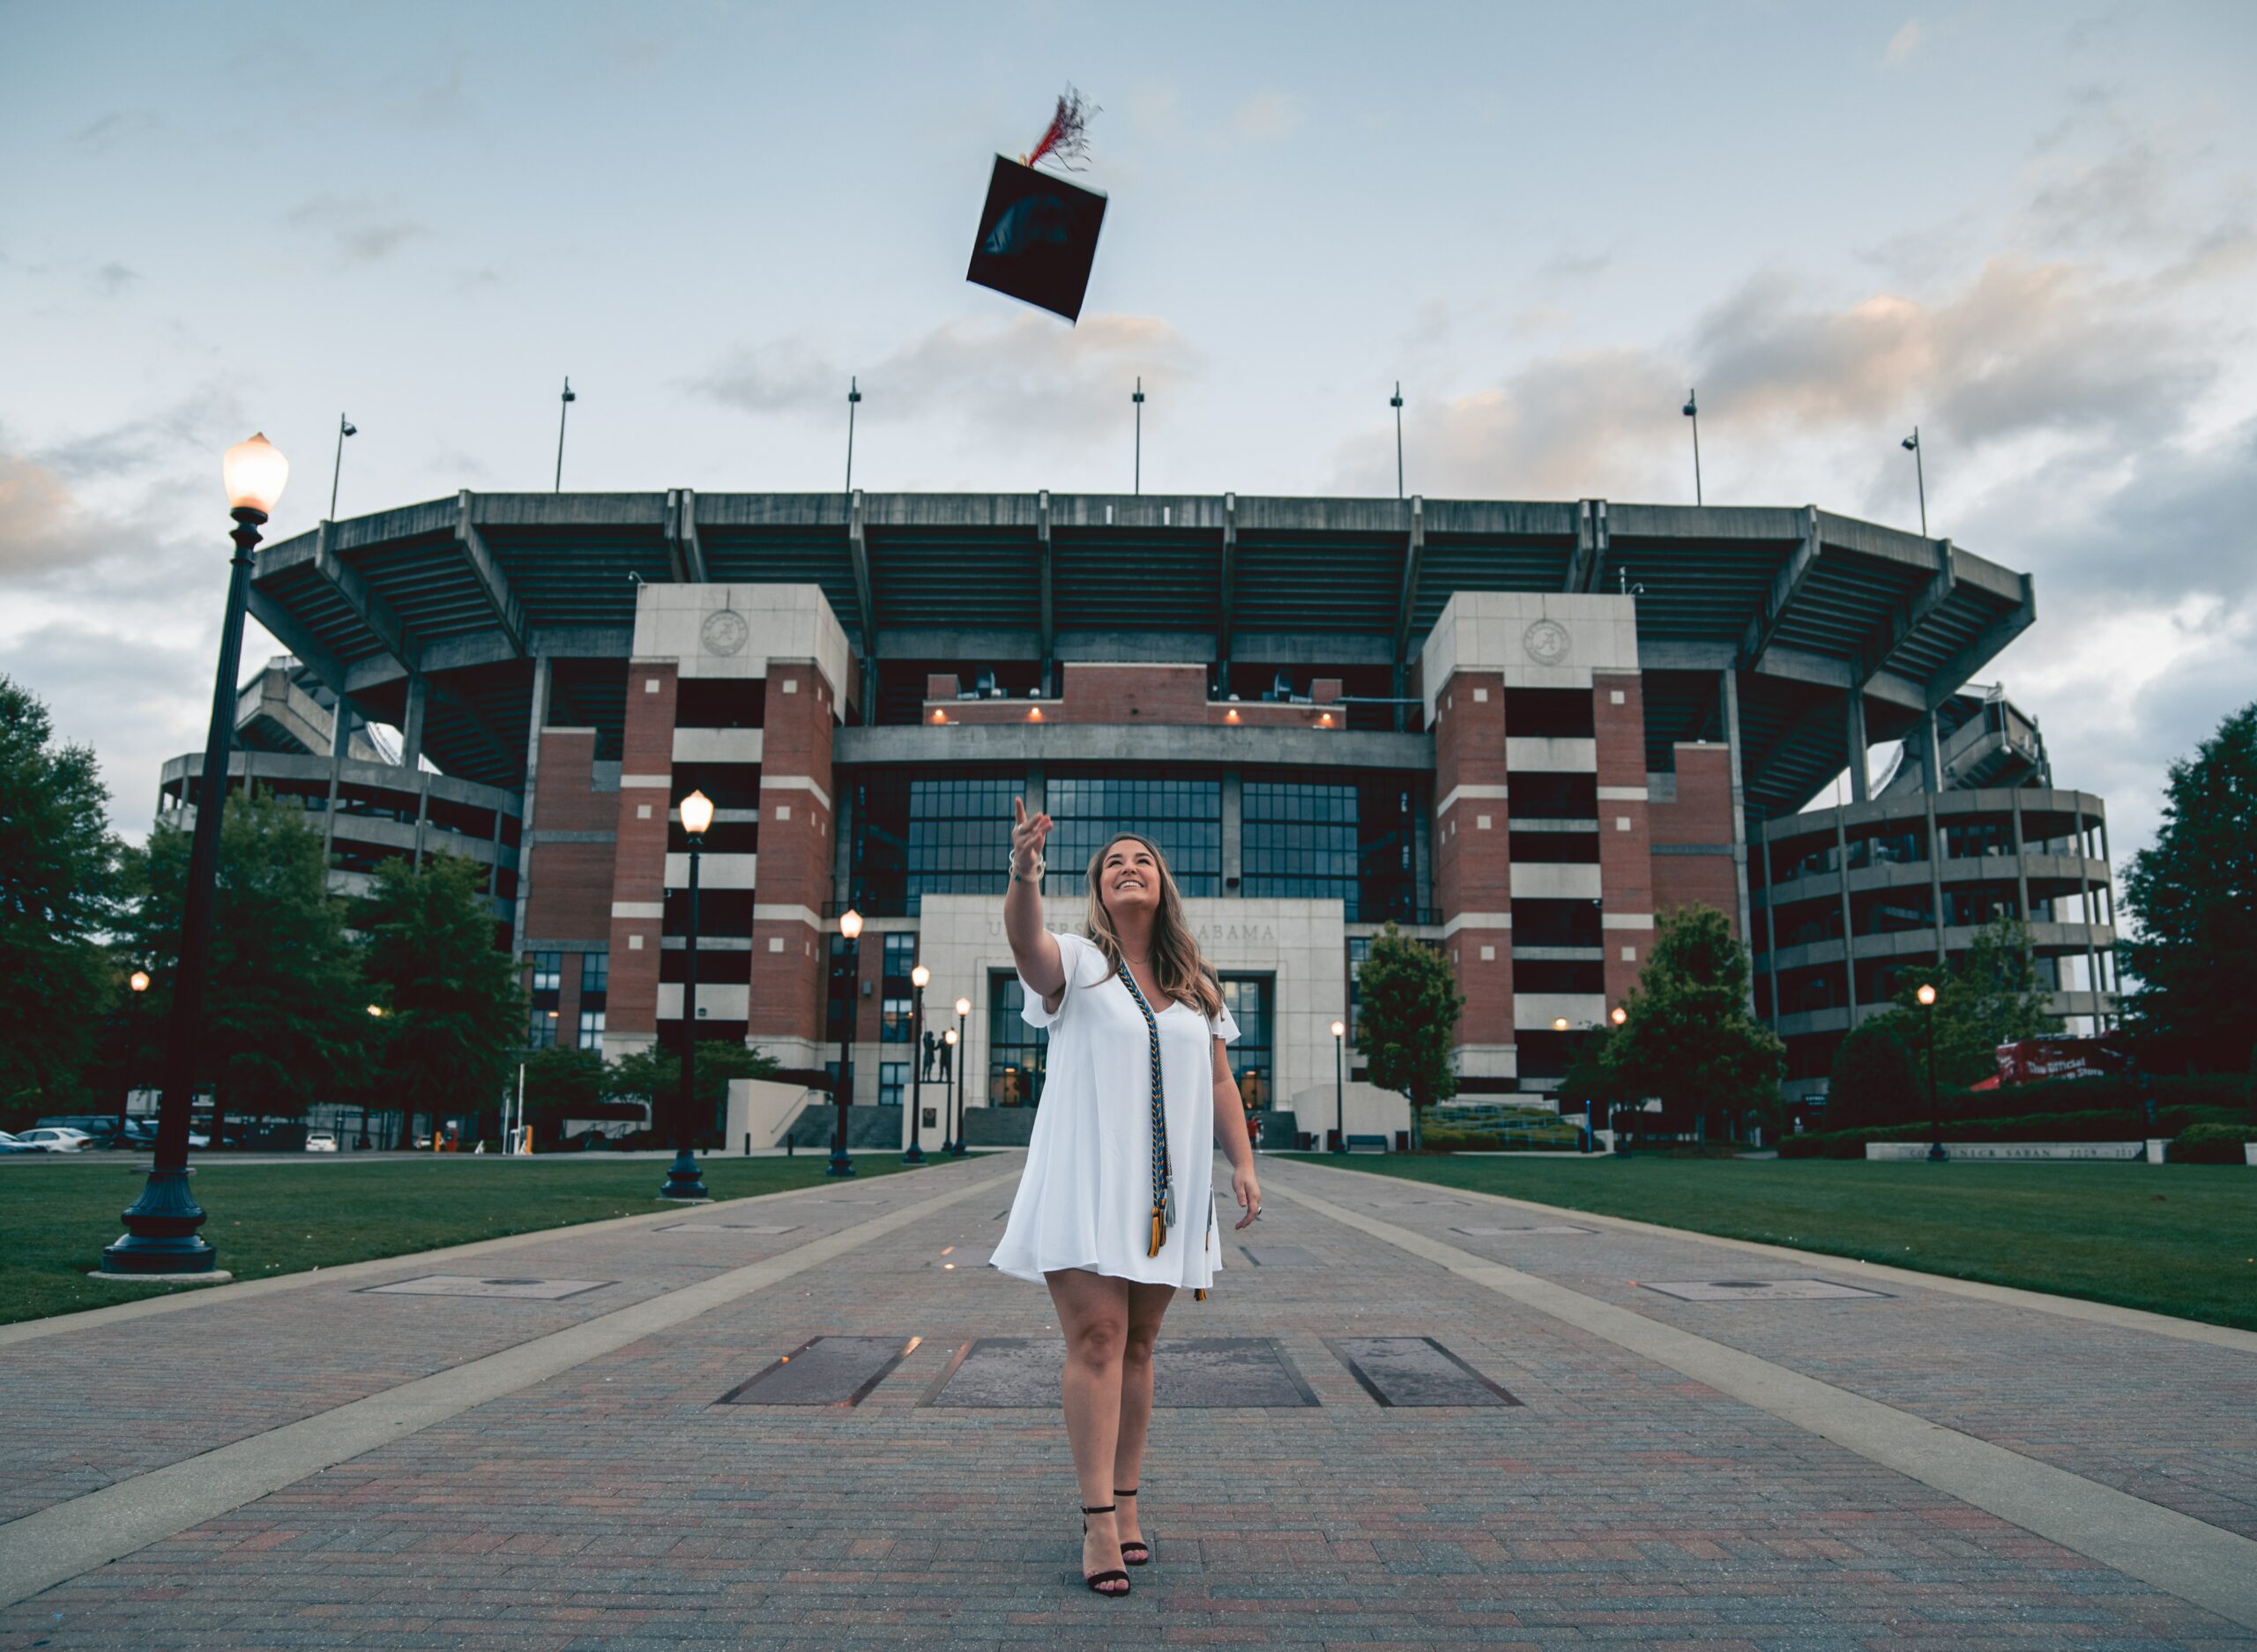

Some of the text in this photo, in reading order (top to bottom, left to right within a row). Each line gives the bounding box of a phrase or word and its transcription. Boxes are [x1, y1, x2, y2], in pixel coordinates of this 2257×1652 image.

[1197, 924, 1274, 940] ABAMA
[1960, 1149, 1997, 1157] NICK
[2005, 1149, 2051, 1157] SABAN
